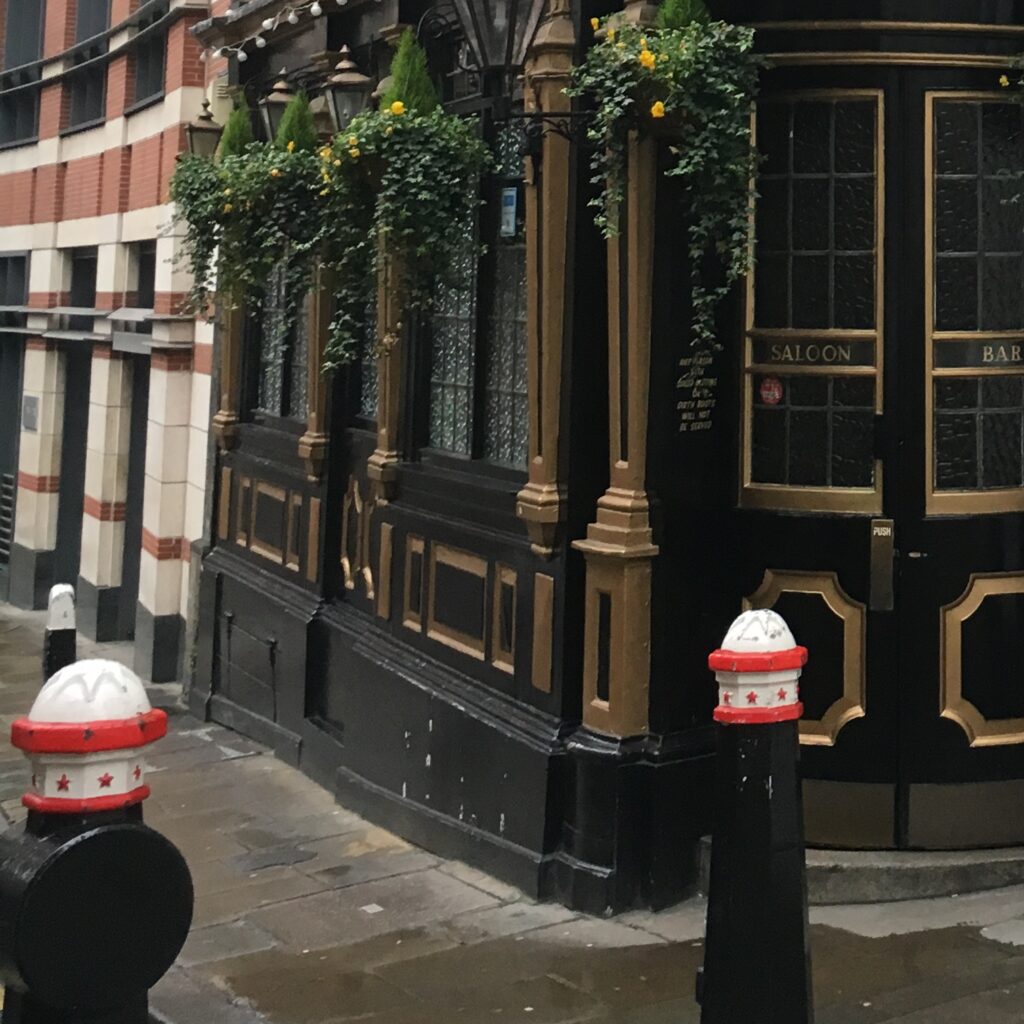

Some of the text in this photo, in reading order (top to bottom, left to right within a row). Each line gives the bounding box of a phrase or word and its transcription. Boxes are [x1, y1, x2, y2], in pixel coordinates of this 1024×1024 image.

[771, 343, 851, 362] SALOON
[982, 345, 1023, 362] BAR
[873, 527, 891, 536] PUSH
